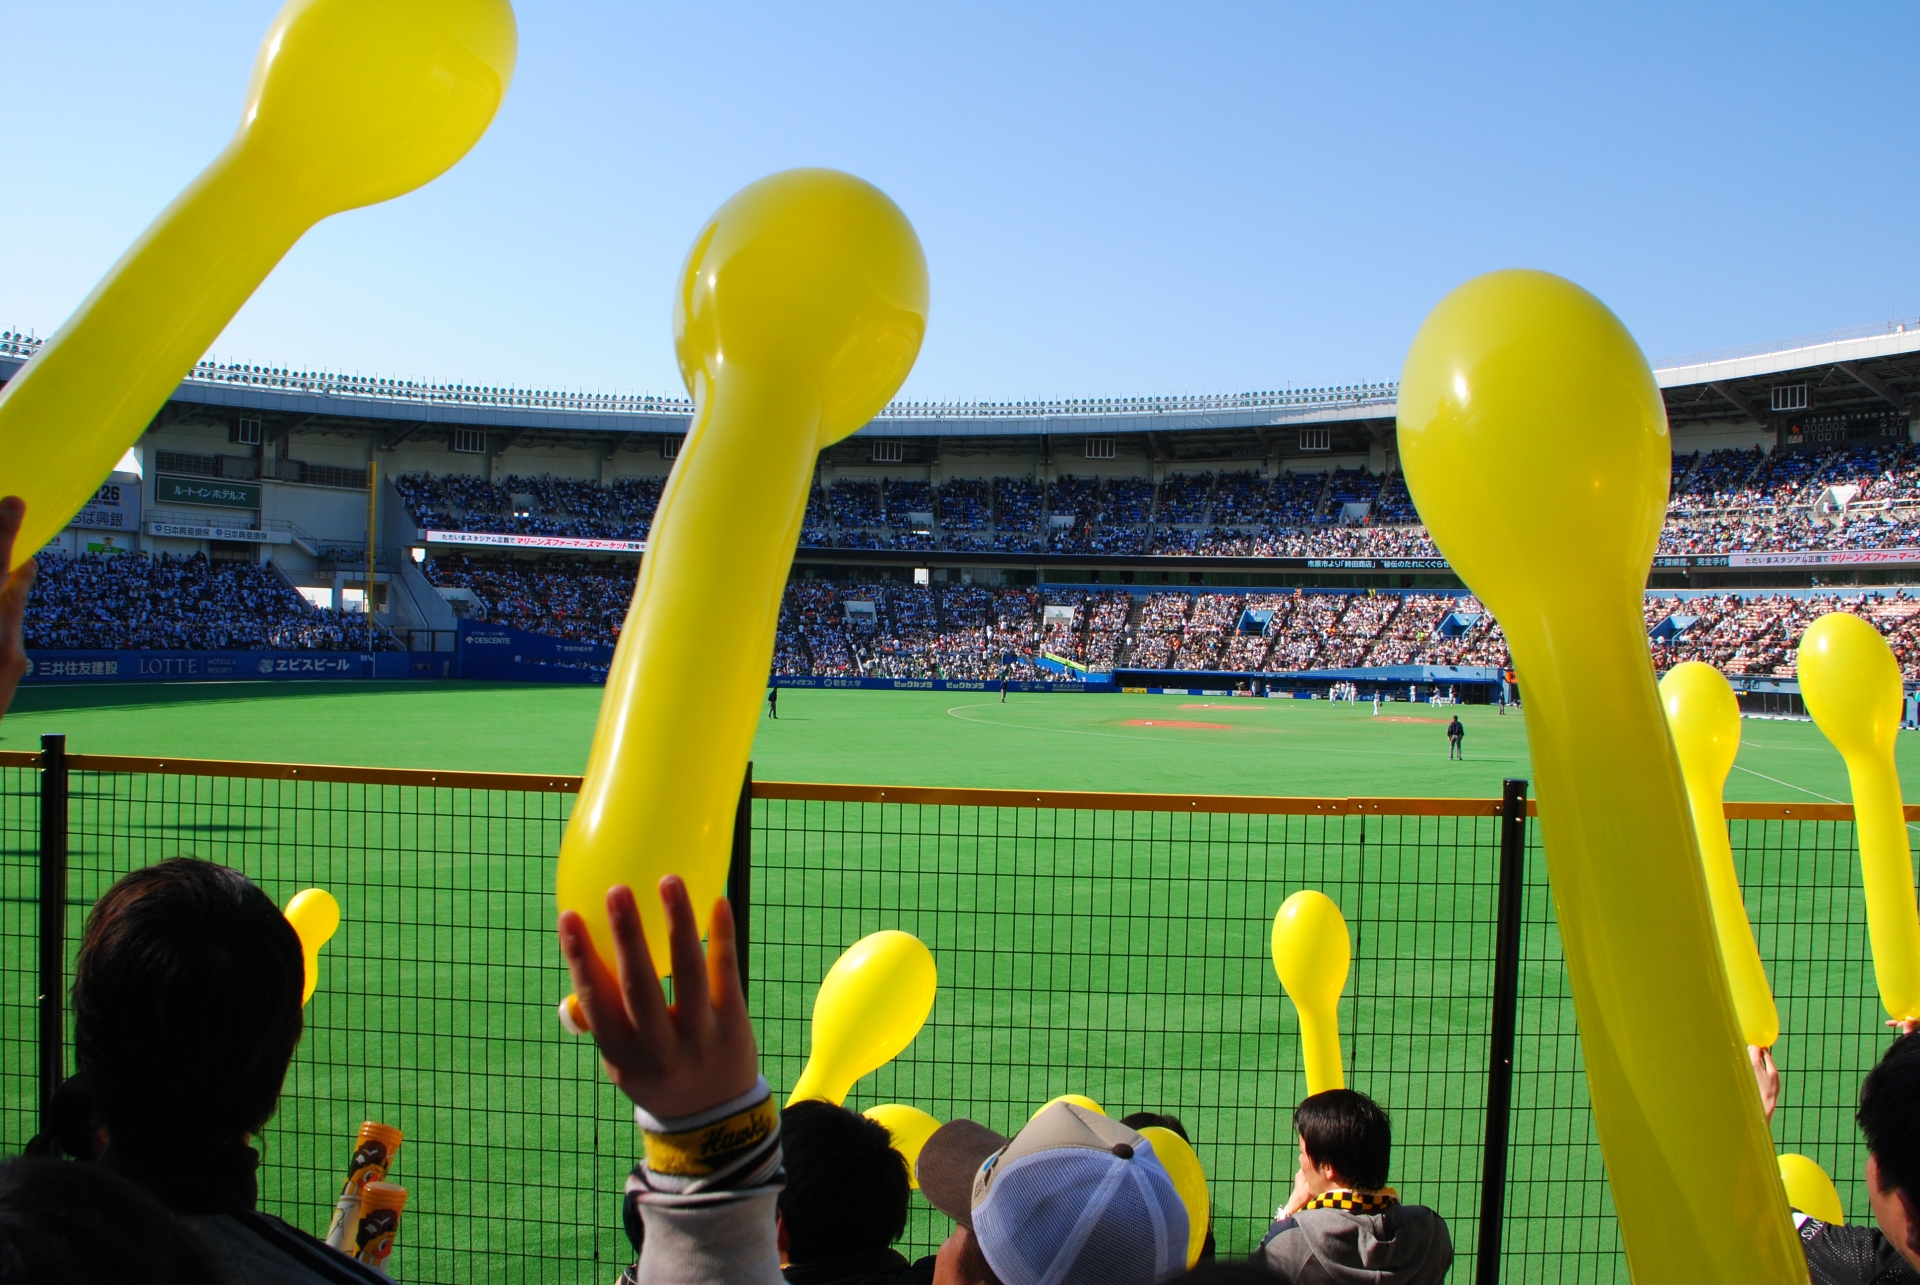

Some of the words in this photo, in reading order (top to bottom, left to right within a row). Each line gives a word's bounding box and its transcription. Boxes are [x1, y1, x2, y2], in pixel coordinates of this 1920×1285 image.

[163, 525, 210, 537] 日本興亜損保
[224, 529, 268, 541] 日本興亜損保
[474, 637, 511, 645] DESCENTE
[39, 660, 118, 676] 三井住友建設
[139, 658, 198, 674] LOTTE
[893, 680, 933, 689] ビックカメラ
[946, 681, 985, 690] ビックカメラ
[700, 1111, 772, 1156] Hawks
[1800, 1218, 1825, 1241] WKS
